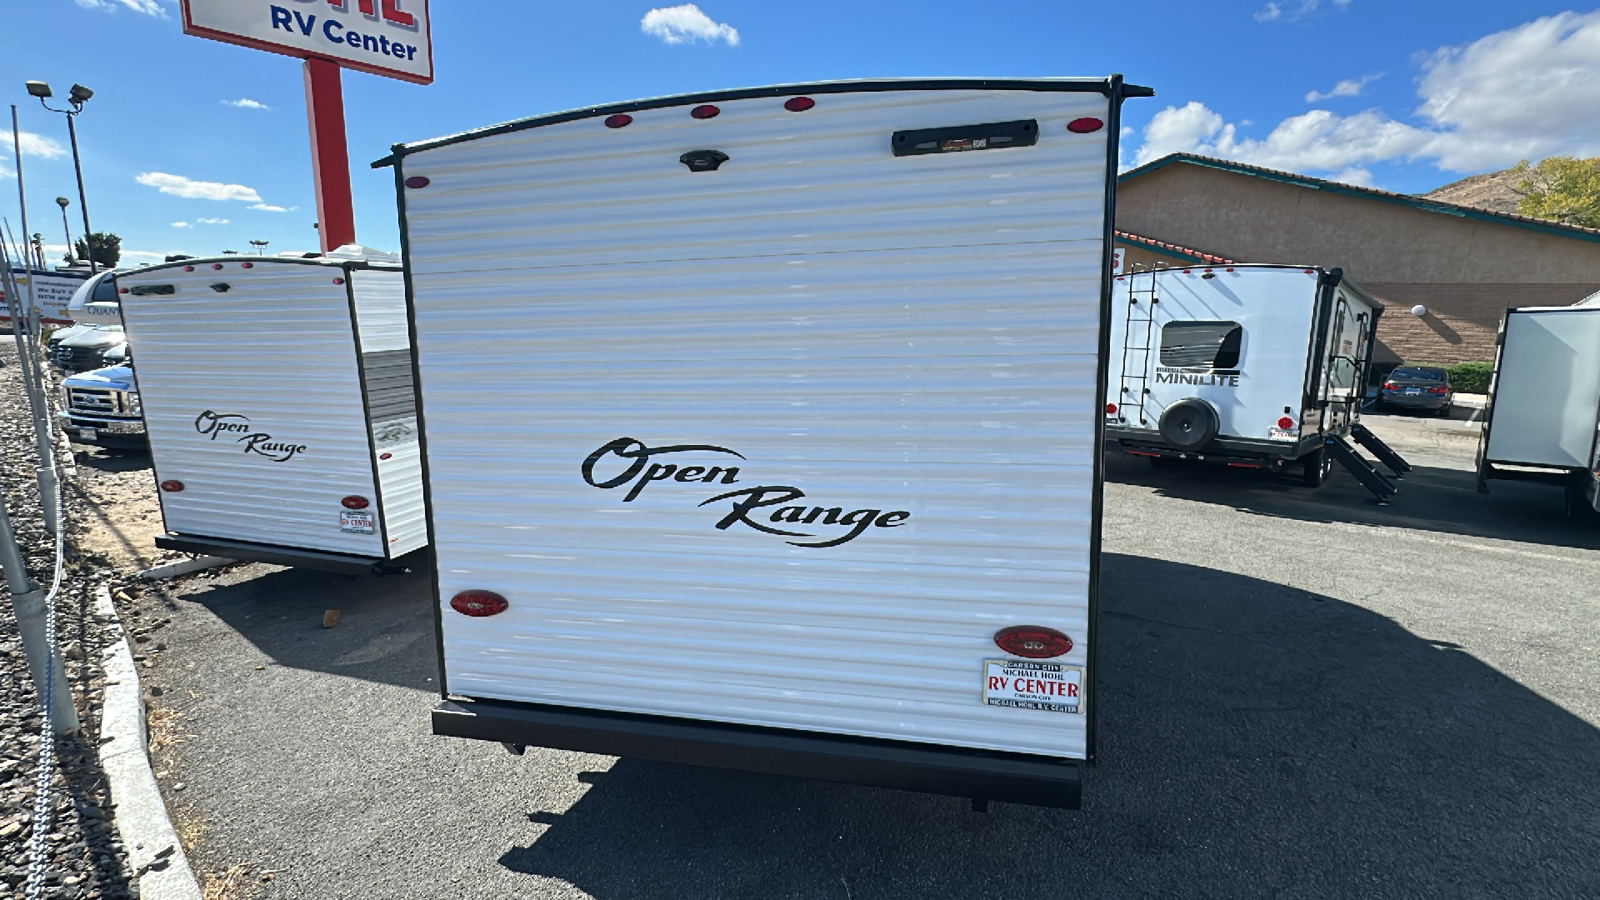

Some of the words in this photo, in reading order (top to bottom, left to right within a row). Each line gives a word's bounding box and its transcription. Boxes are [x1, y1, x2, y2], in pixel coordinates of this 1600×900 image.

[271, 5, 316, 37] RV
[323, 19, 418, 61] Center
[1156, 372, 1239, 387] MINILITE
[195, 410, 250, 440] Open
[238, 433, 307, 462] Range
[581, 437, 747, 502] Open
[698, 486, 910, 548] Range
[1002, 669, 1039, 679] MICHAEL
[1041, 671, 1065, 681] HOHL
[1008, 661, 1040, 669] CARSON
[988, 676, 1009, 691] RV
[1013, 677, 1078, 697] CENTER
[989, 698, 1018, 707] MICHAEL
[1018, 701, 1036, 709] HOHL
[1050, 704, 1077, 713] CENTER
